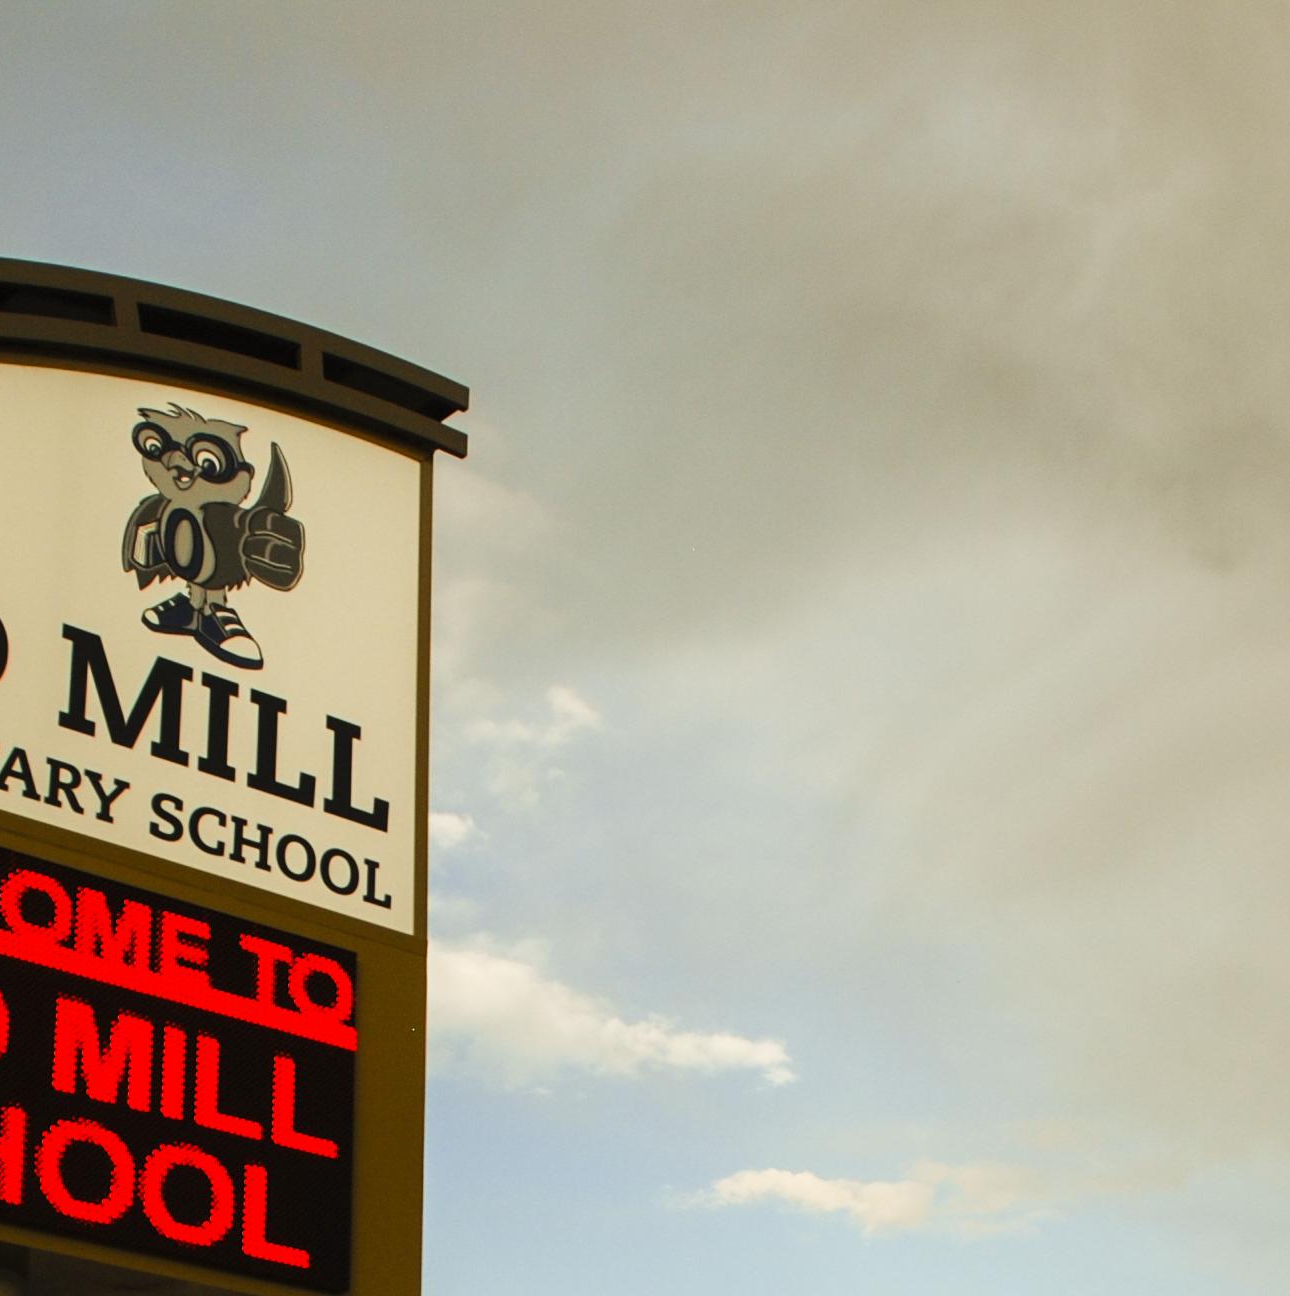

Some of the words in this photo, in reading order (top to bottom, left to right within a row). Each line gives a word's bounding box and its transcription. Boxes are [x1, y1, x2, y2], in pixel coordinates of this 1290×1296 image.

[58, 623, 391, 832] MILL
[149, 793, 393, 910] SCHOOL
[239, 934, 355, 1023] TO
[51, 995, 340, 1159] MILL
